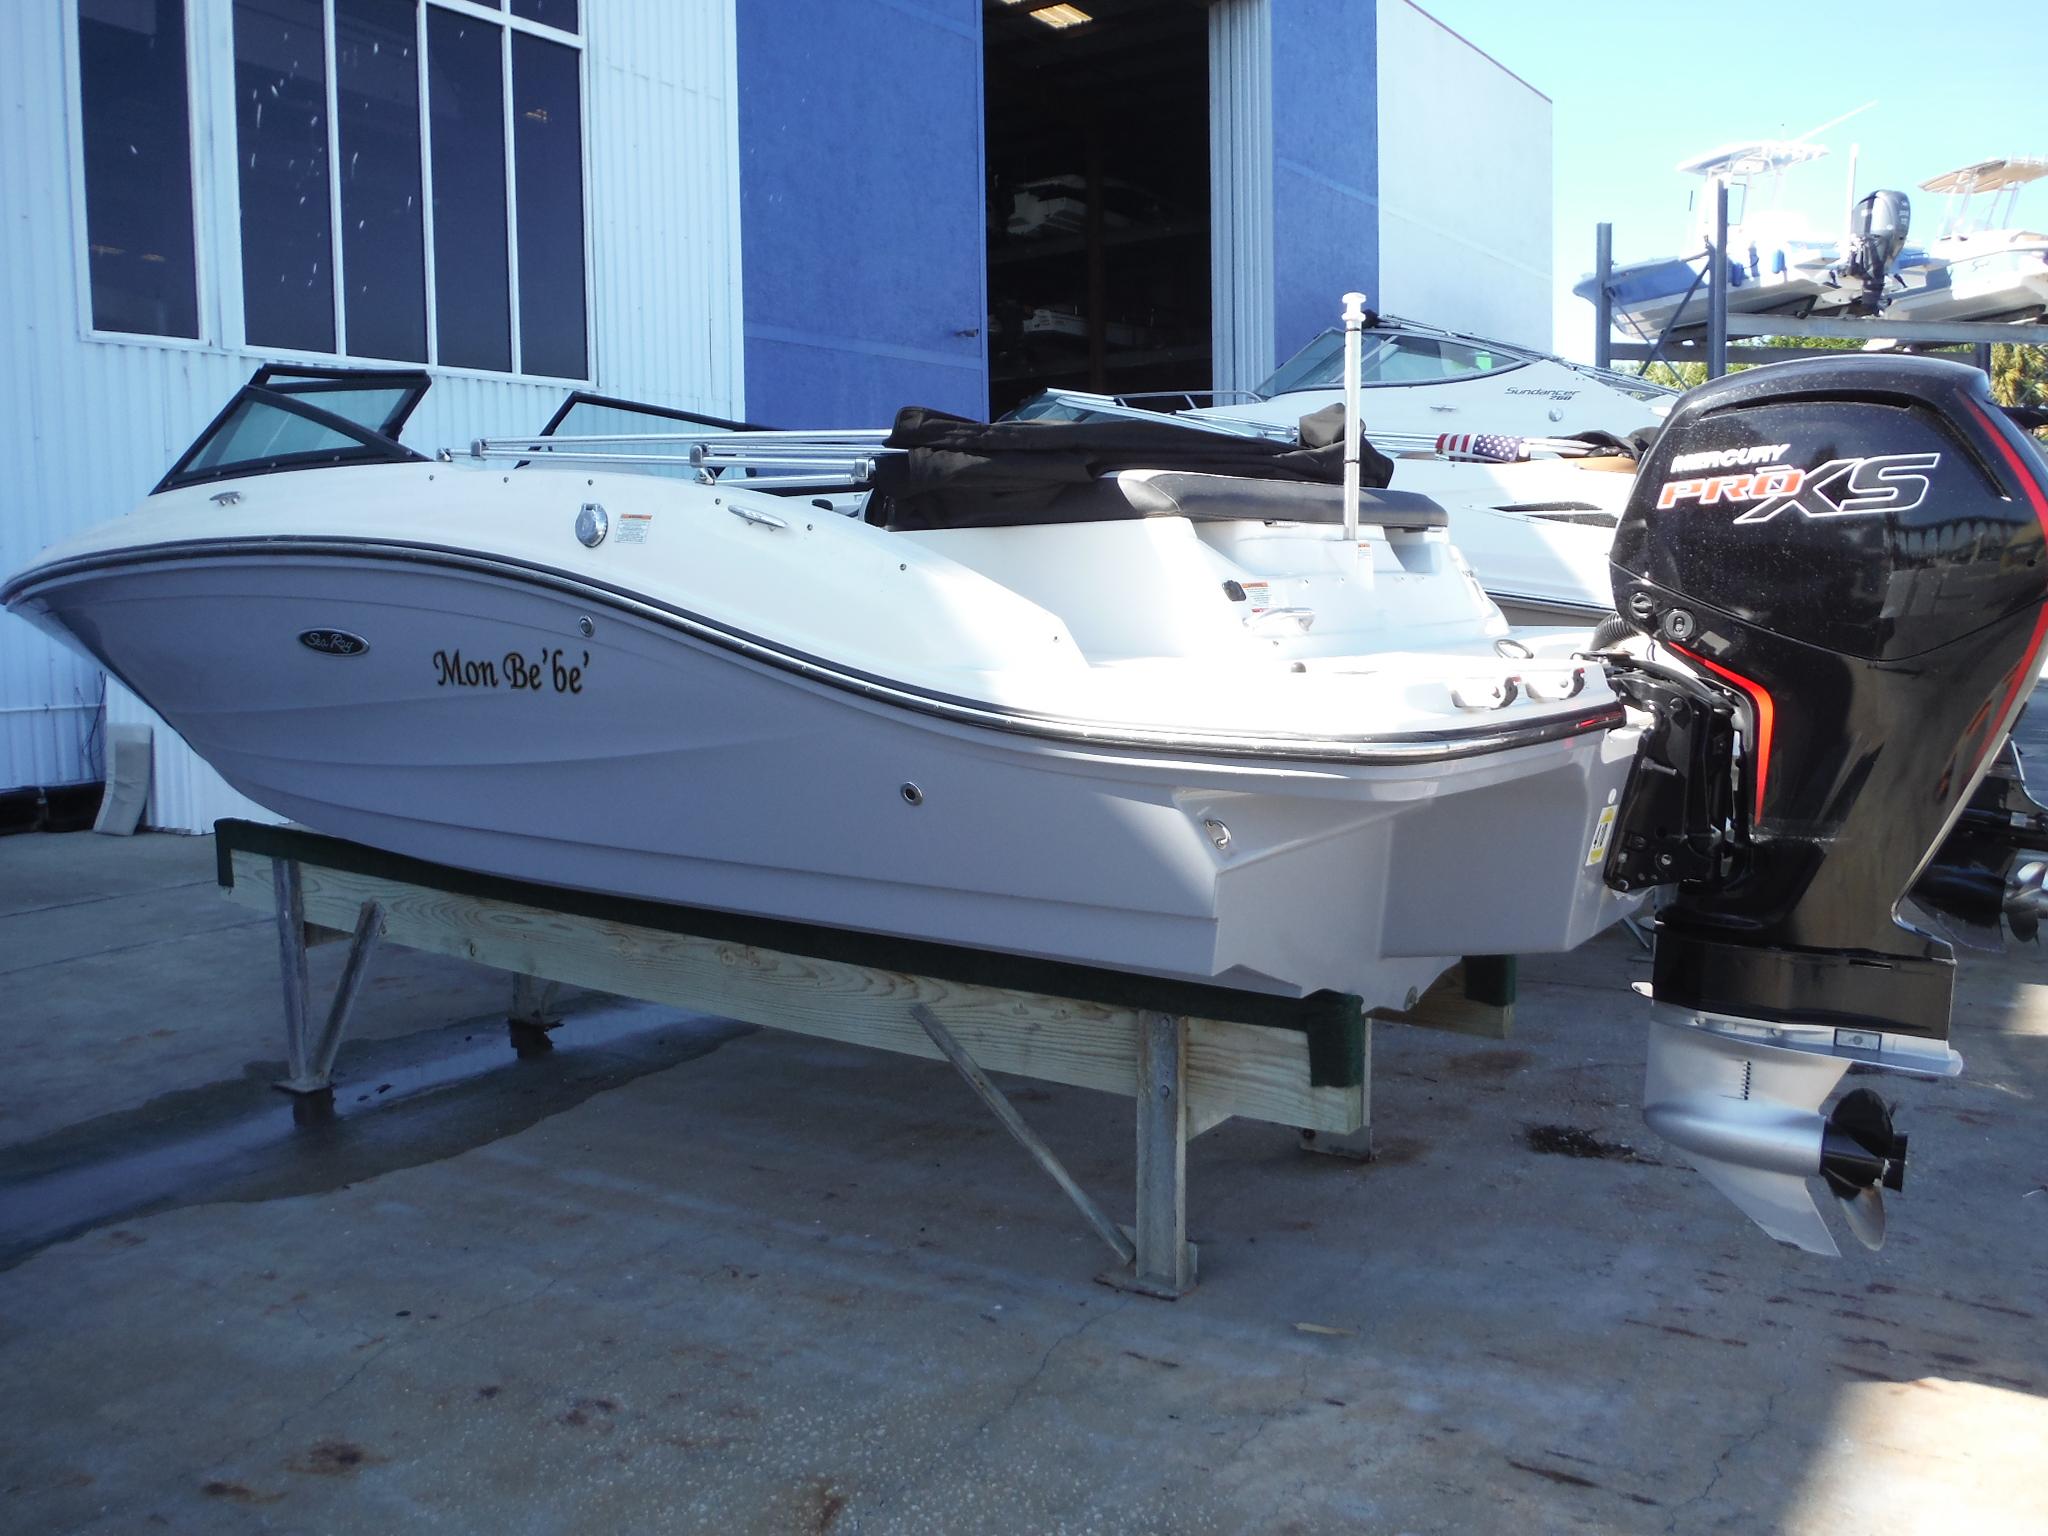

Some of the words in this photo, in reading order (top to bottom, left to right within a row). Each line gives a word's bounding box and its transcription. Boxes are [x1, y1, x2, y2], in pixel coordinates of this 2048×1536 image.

[1504, 386, 1581, 396] Sundancer
[1670, 443, 1791, 473] MERCURY
[304, 632, 329, 649] Sea
[330, 633, 354, 653] Ray
[433, 649, 498, 687] Mon
